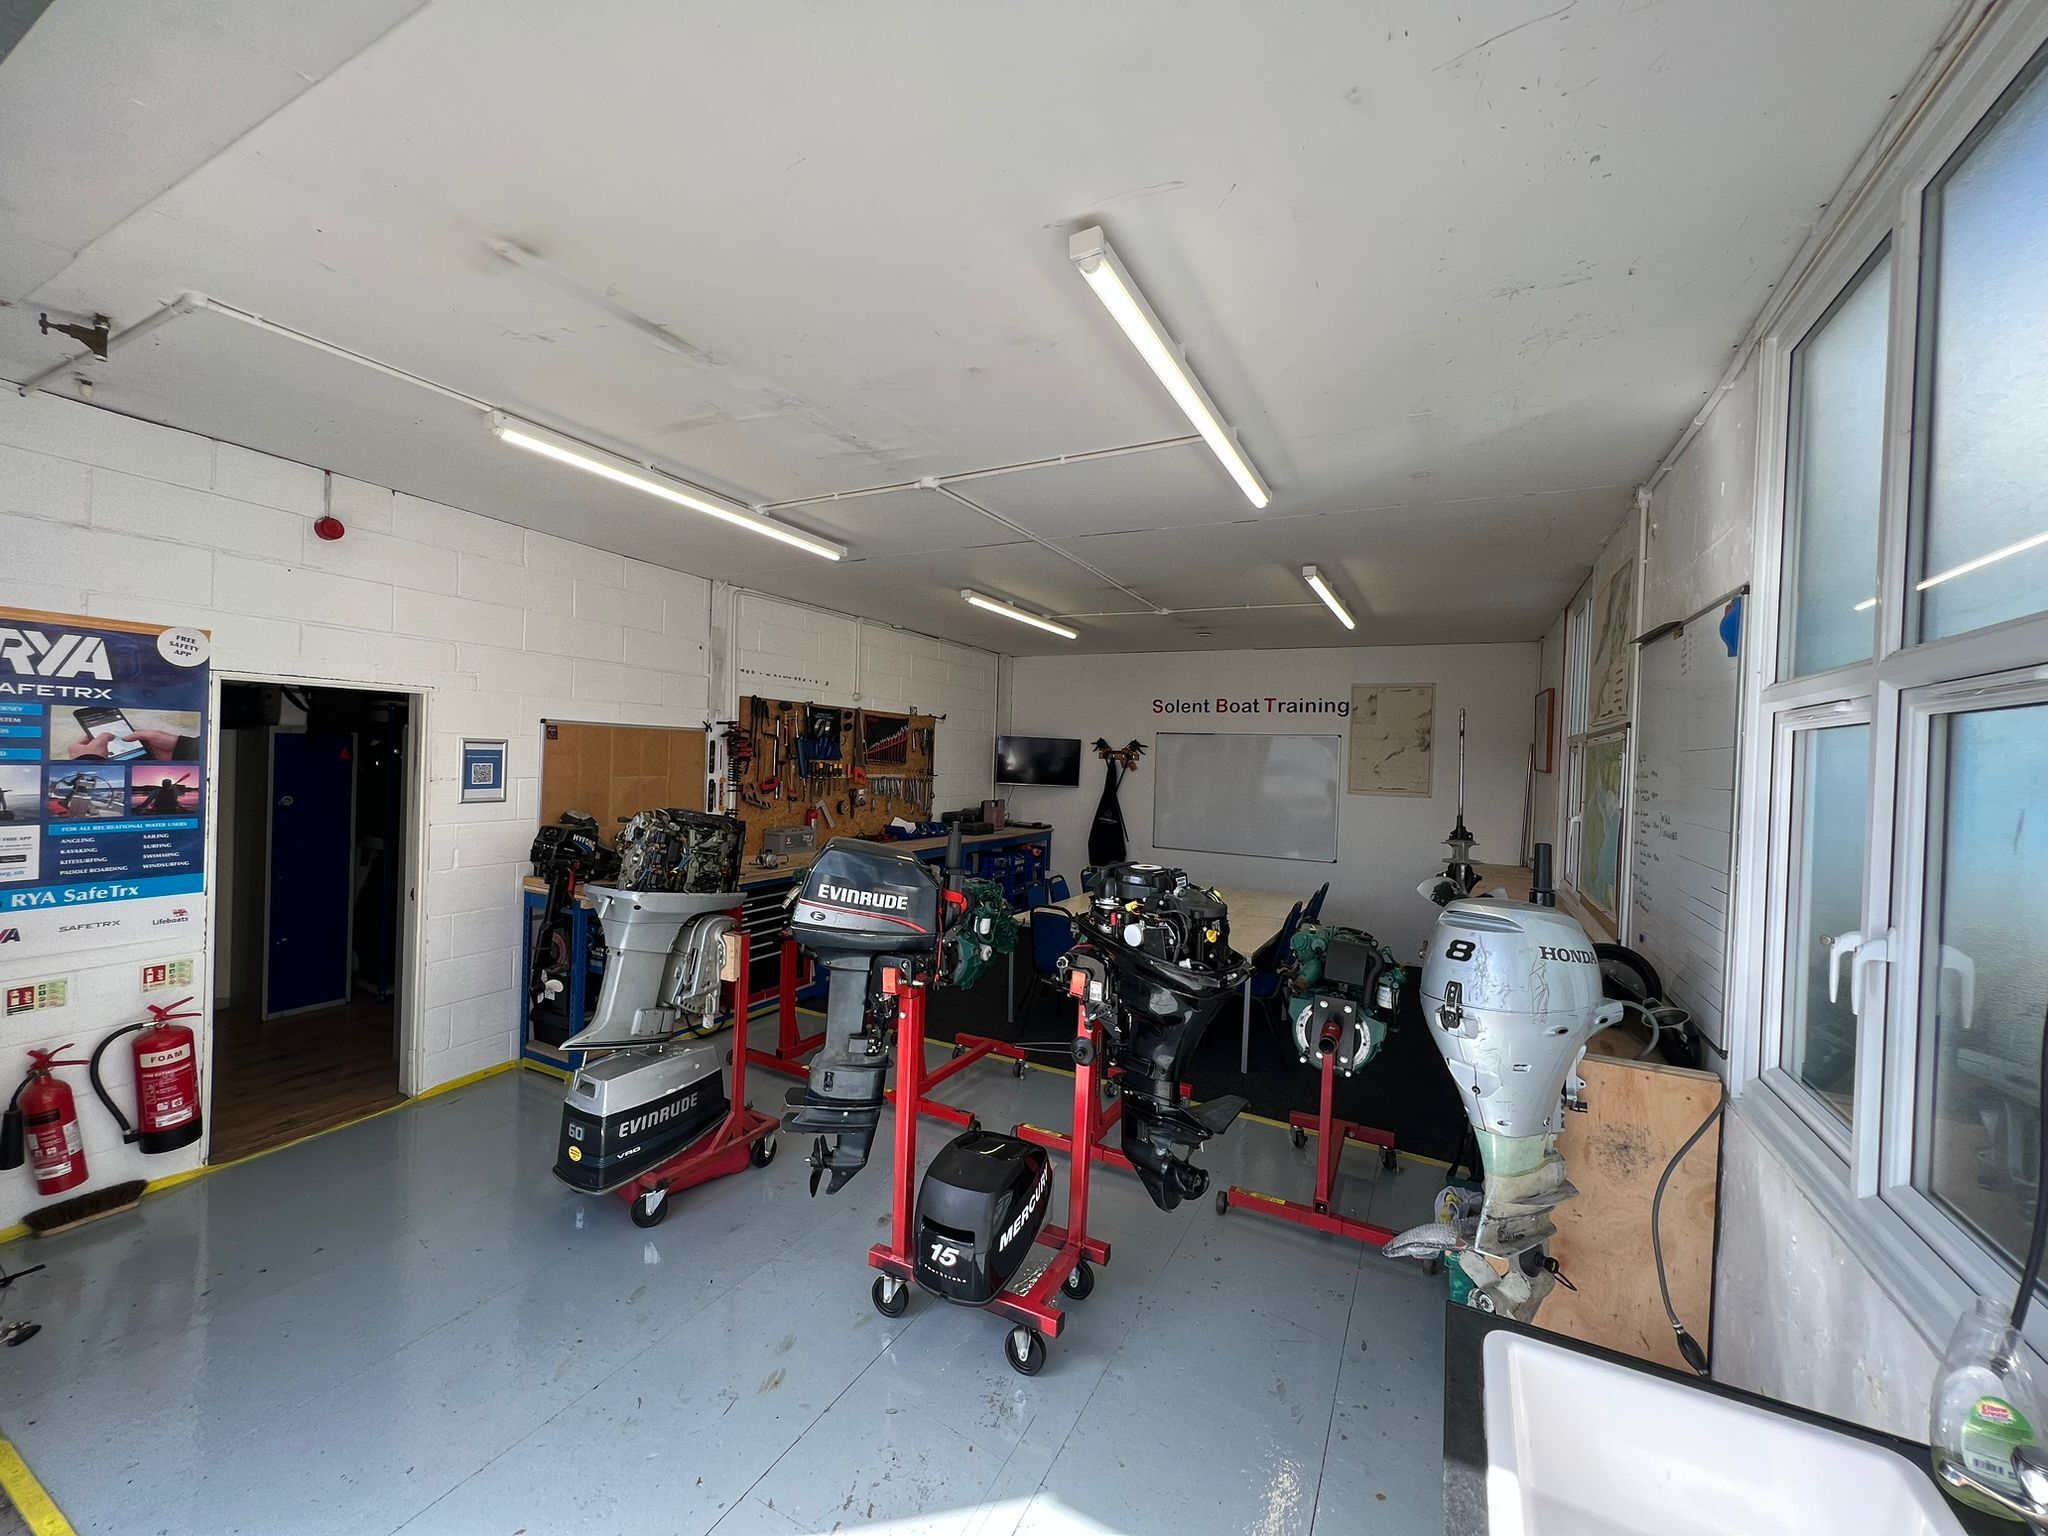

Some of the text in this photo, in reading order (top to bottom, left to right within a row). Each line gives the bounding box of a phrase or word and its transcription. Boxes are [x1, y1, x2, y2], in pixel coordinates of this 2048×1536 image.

[169, 640, 199, 652] SAFETY
[176, 634, 197, 644] FREE
[0, 628, 113, 681] RYA
[174, 649, 192, 657] APP
[0, 682, 113, 700] AFETRX
[1152, 697, 1350, 718] Solent Boat Training
[93, 823, 143, 831] RECREATIONAL
[60, 847, 98, 855] KAYAKING
[143, 842, 173, 850] SURFING
[60, 856, 108, 865] KITESURFING
[142, 852, 181, 860] SWIMMING
[60, 865, 129, 876] PADDLE BOARDING
[142, 860, 190, 869] WINDSURFING
[11, 884, 139, 908] RYA SafeTrx
[818, 883, 909, 910] EVINRUDE
[58, 919, 121, 933] SAFETRX
[152, 916, 189, 926] Lifeboats
[1446, 939, 1476, 962] 8
[1539, 946, 1598, 965] HONDA
[150, 1049, 183, 1064] FOAM
[618, 1091, 699, 1138] EVINRUDE
[568, 1122, 585, 1141] 60
[999, 1162, 1049, 1252] MERCURY
[930, 1242, 960, 1267] 15
